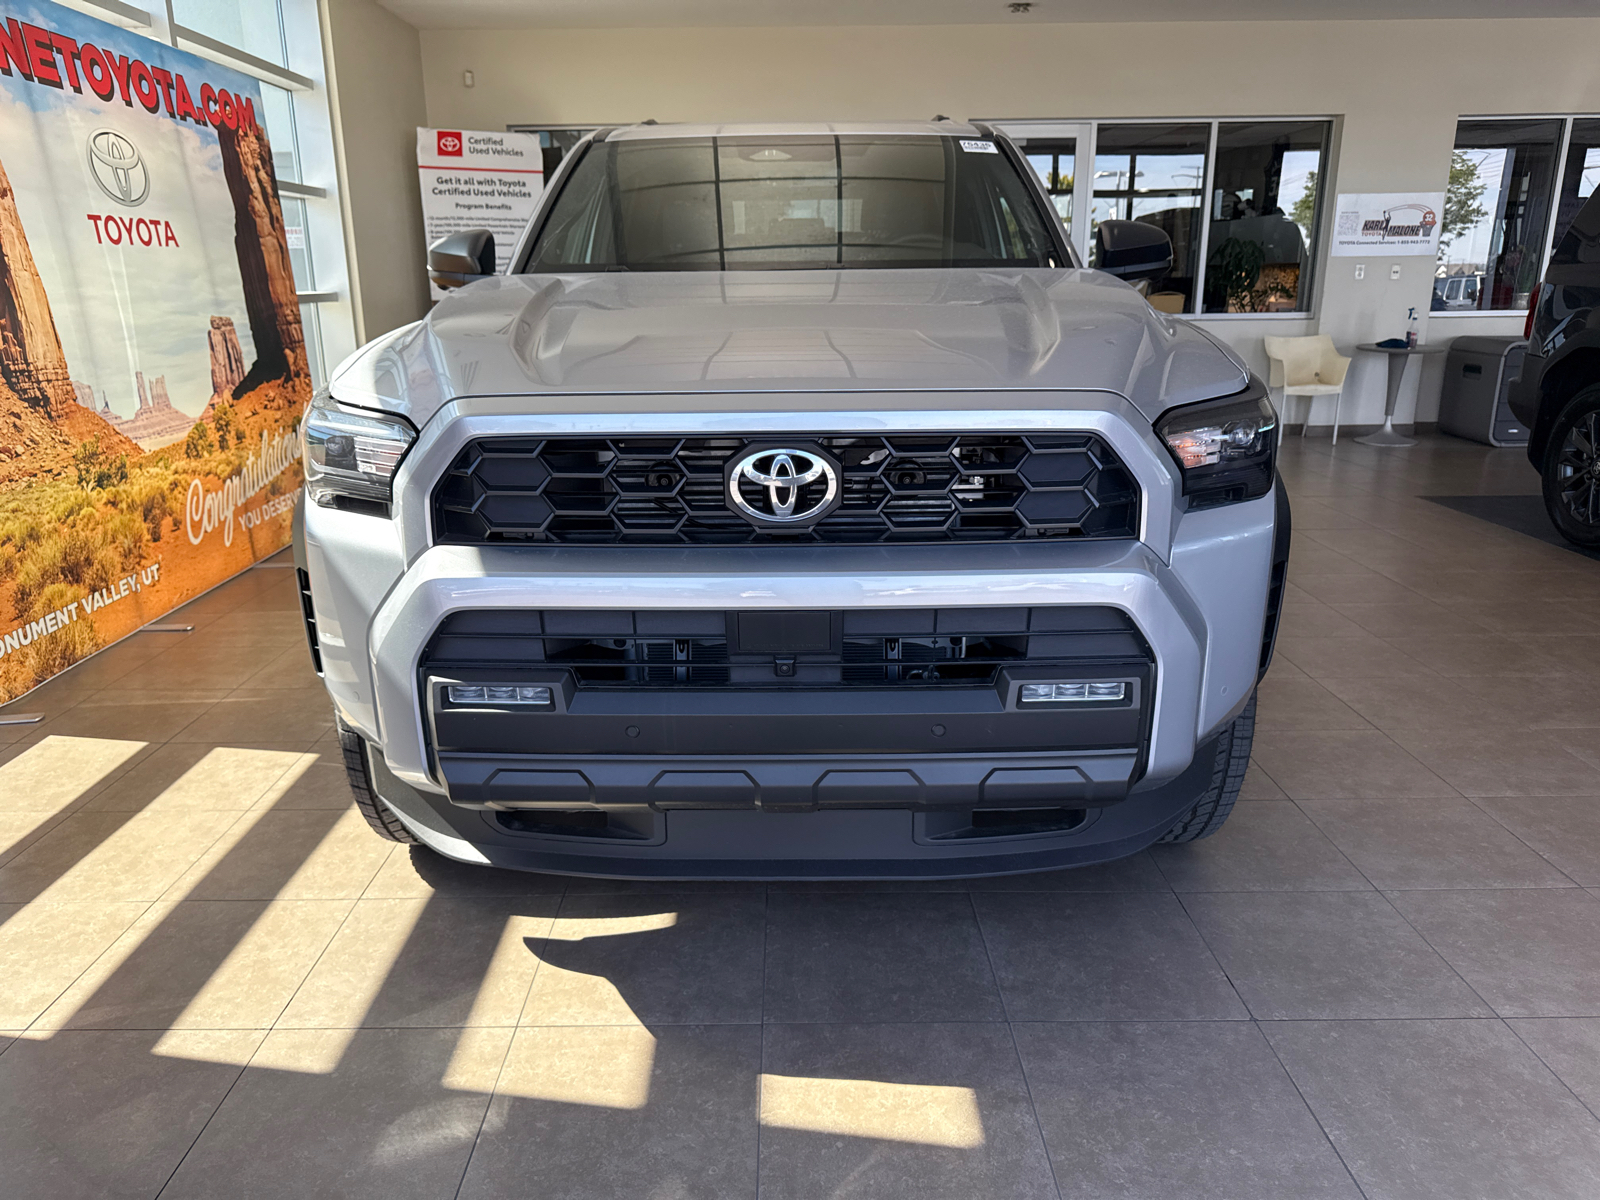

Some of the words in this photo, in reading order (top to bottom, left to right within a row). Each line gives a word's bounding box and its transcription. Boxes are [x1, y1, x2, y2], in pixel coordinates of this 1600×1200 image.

[0, 16, 259, 136] NETOYOTA.COM
[468, 136, 504, 146] Certified
[468, 146, 492, 155] Used
[492, 147, 524, 157] Vehicles
[436, 176, 454, 185] Get
[455, 177, 462, 185] it
[463, 177, 475, 186] all
[476, 178, 496, 187] with
[497, 178, 526, 188] Toyota
[432, 187, 471, 196] Certified
[473, 188, 495, 197] Used
[496, 188, 532, 198] Vehicles
[455, 202, 484, 211] Program
[485, 203, 512, 211] Benefits
[1424, 213, 1433, 222] 32
[87, 214, 180, 248] TOYOTA
[1362, 220, 1385, 231] KARL
[1387, 225, 1421, 236] MALONE
[238, 507, 262, 531] YOU
[81, 573, 141, 615] VALLEY,
[141, 563, 160, 586] UT
